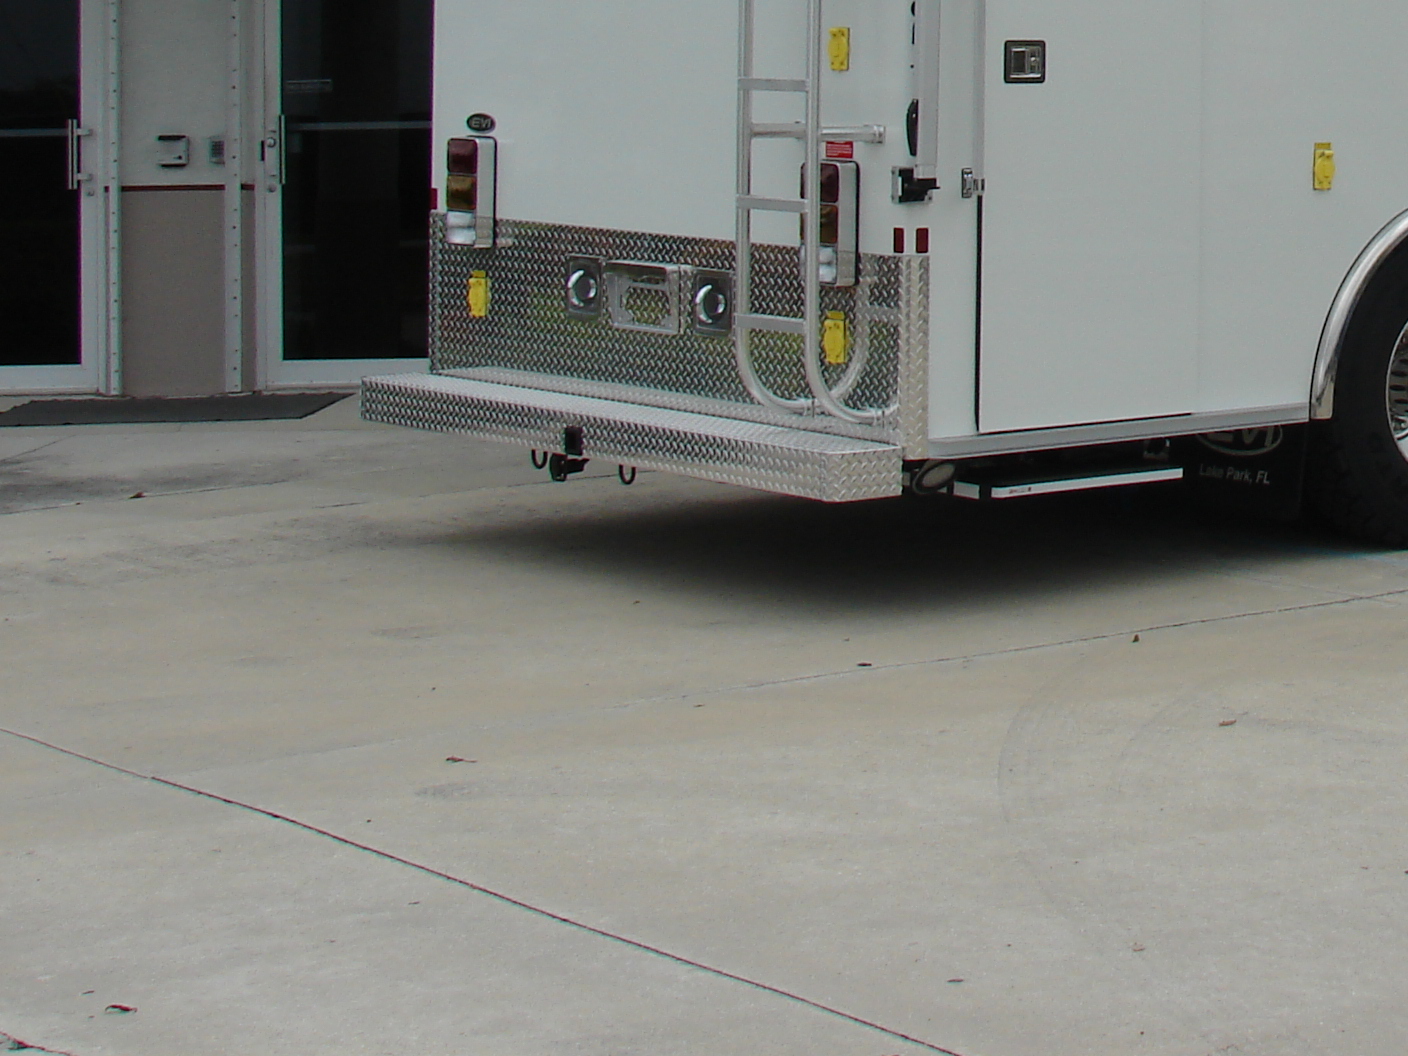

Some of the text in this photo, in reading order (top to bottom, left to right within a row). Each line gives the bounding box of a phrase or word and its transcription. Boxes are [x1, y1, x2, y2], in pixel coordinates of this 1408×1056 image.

[1200, 463, 1270, 485] Lake Park, FL
